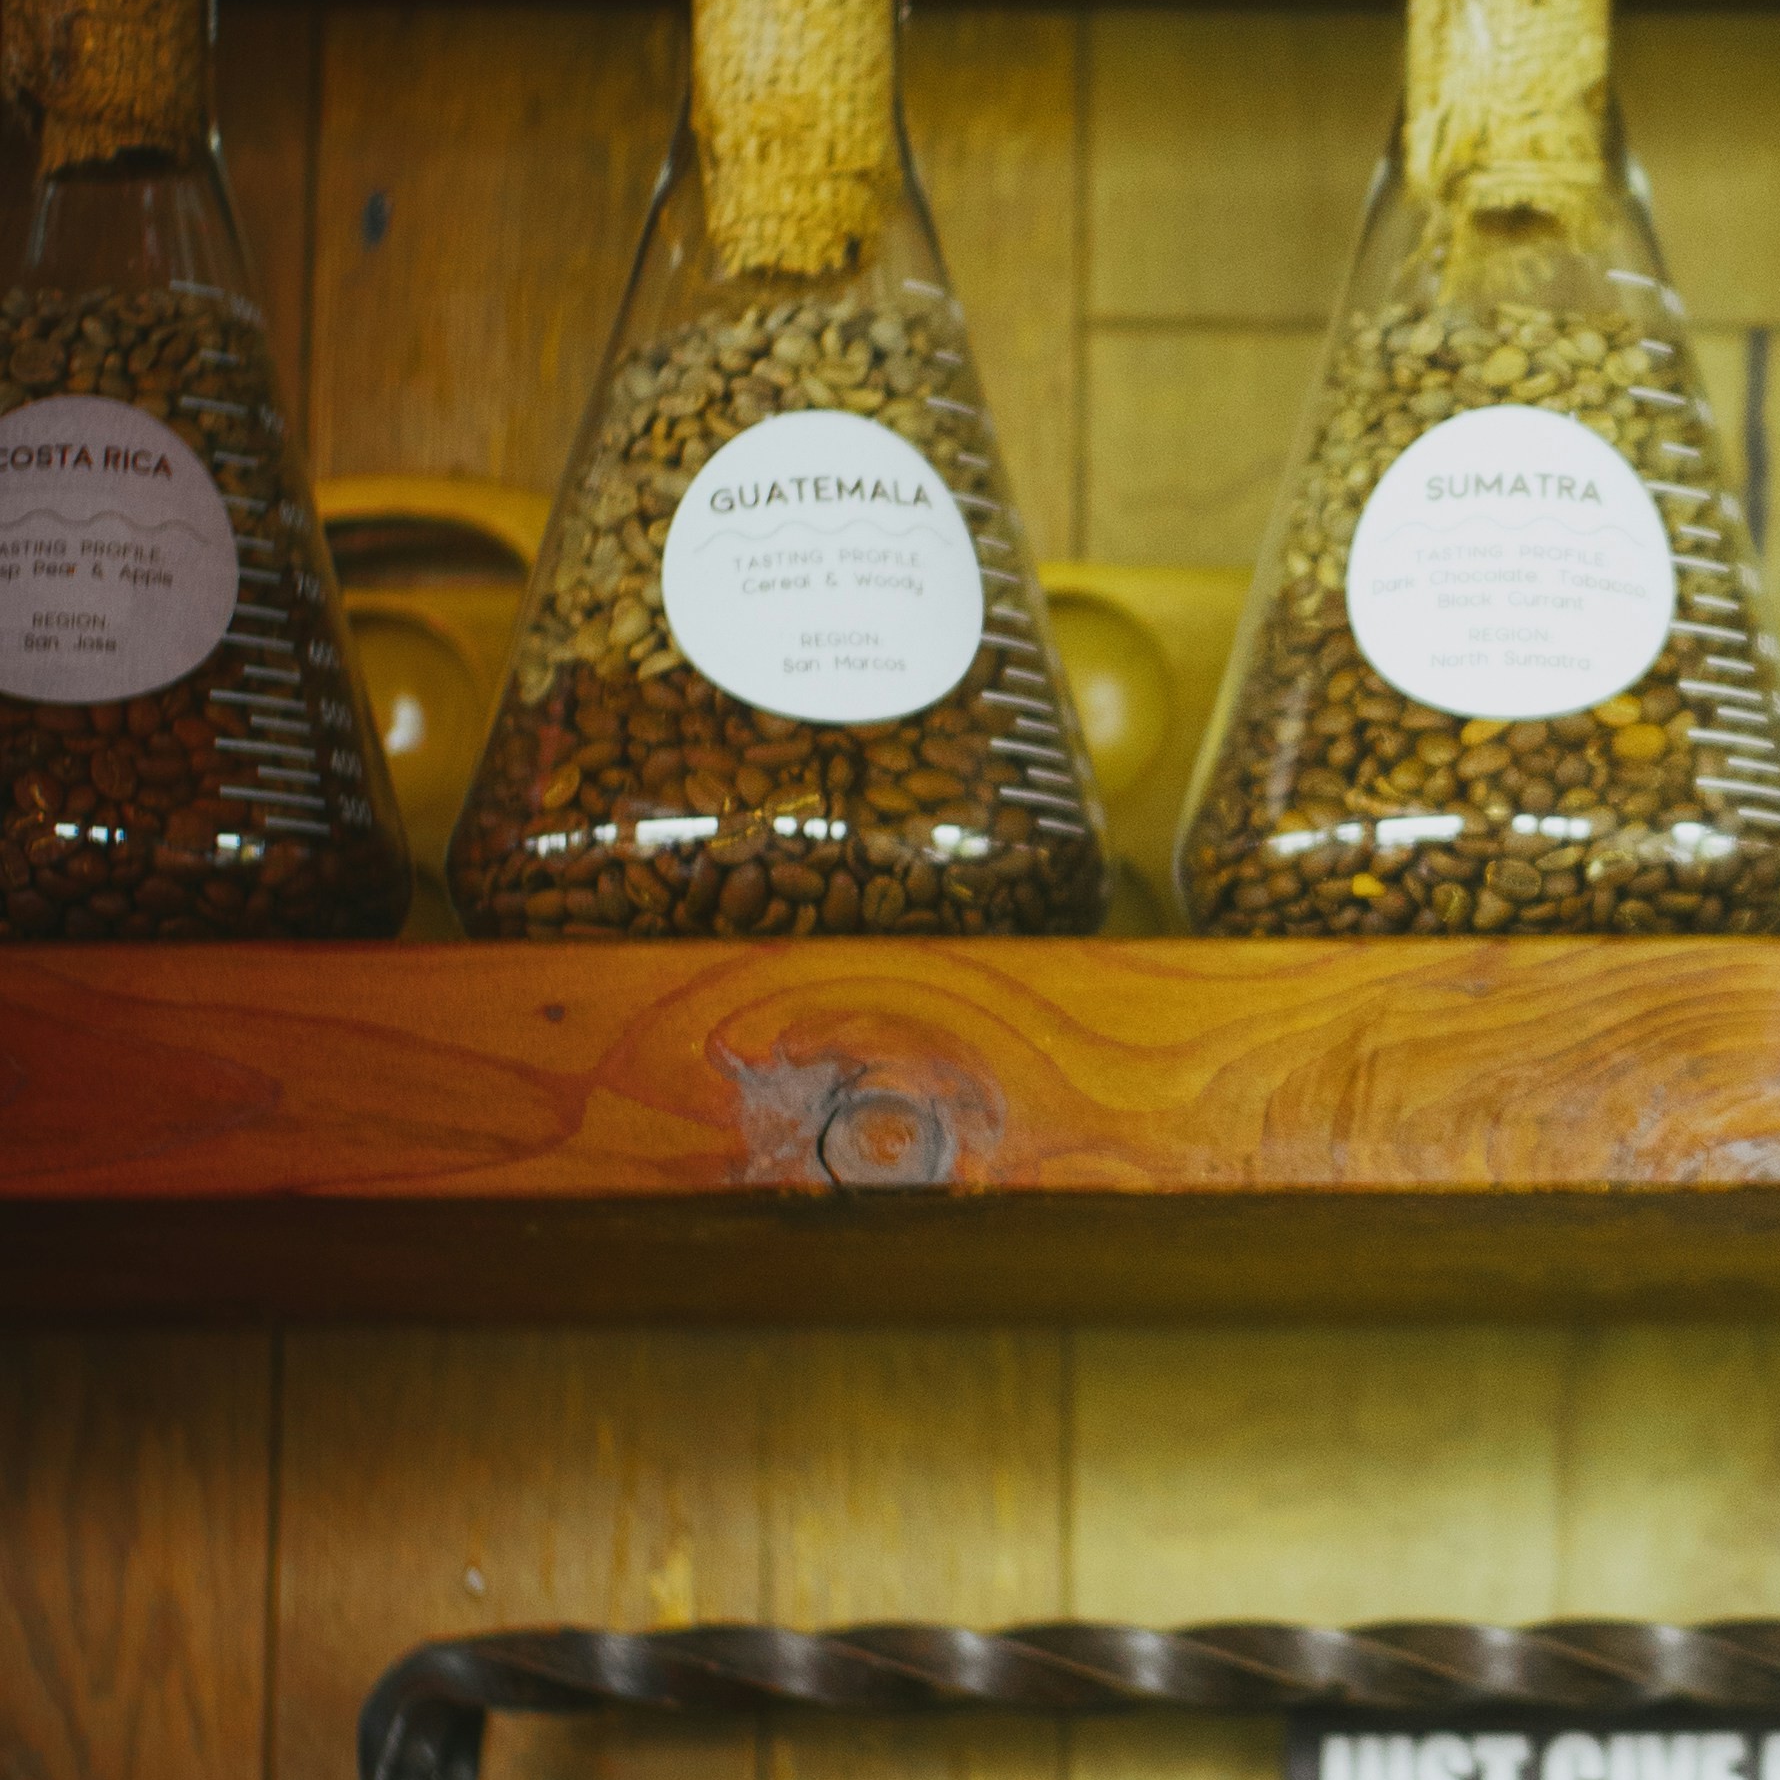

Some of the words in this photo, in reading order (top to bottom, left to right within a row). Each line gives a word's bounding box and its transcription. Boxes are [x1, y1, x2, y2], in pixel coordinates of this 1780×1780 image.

[103, 445, 174, 482] RICA
[709, 474, 933, 515] GUATEMALA
[1425, 472, 1604, 506] SUMATRA
[0, 538, 67, 558] ASTING
[1415, 543, 1504, 564] TASTING
[733, 547, 824, 573] TASTING
[91, 559, 104, 581] &
[119, 563, 174, 589] Apple
[742, 572, 811, 595] Cereal
[825, 571, 838, 588] &
[853, 571, 924, 596] Woody
[1371, 575, 1416, 596] Dark
[1437, 592, 1492, 610] Black
[1507, 590, 1585, 612] Currant
[782, 656, 821, 674] San
[834, 654, 907, 672] Marcos
[1429, 651, 1489, 669] North
[1503, 650, 1592, 671] Sumatra
